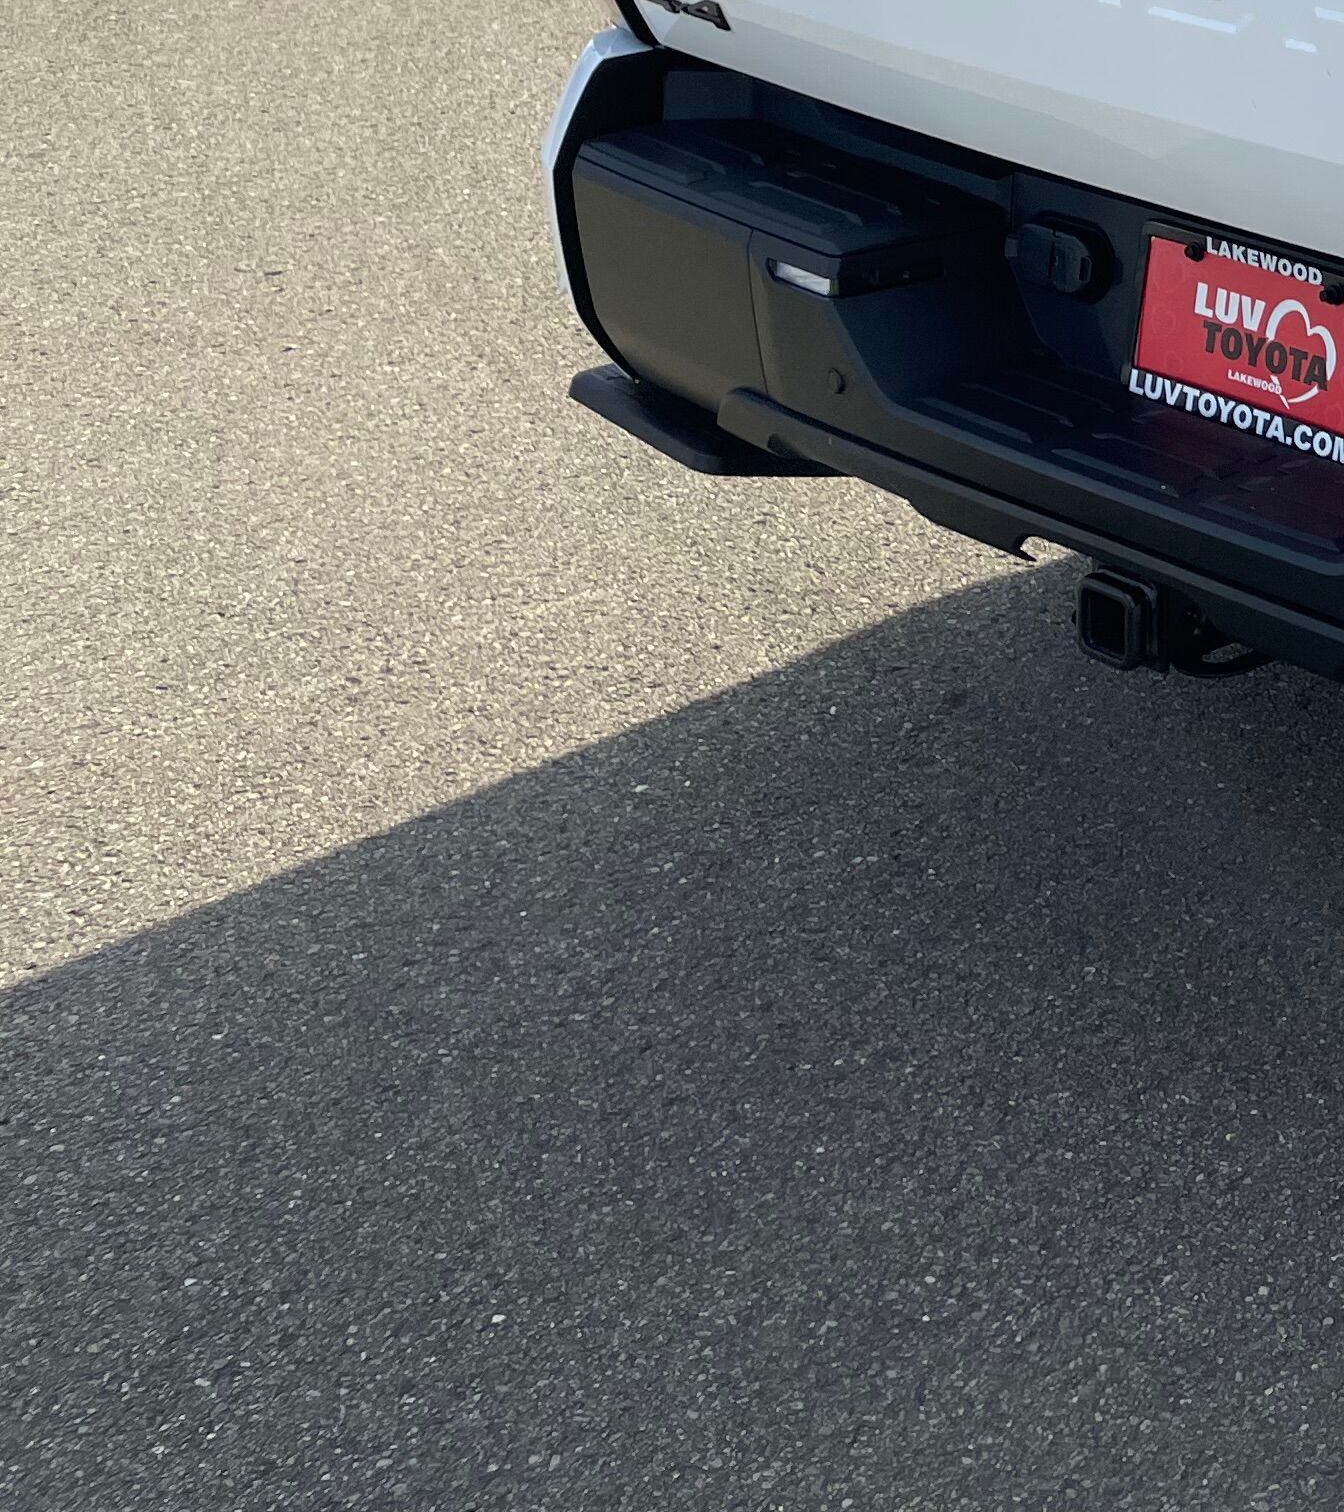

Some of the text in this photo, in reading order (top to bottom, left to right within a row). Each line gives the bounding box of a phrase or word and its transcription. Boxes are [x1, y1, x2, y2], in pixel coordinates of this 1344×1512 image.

[1206, 236, 1323, 286] LAKEWOOD
[1194, 282, 1266, 332] LUV
[1203, 321, 1328, 391] TOYOTA
[1227, 369, 1283, 395] LAKEWOOD
